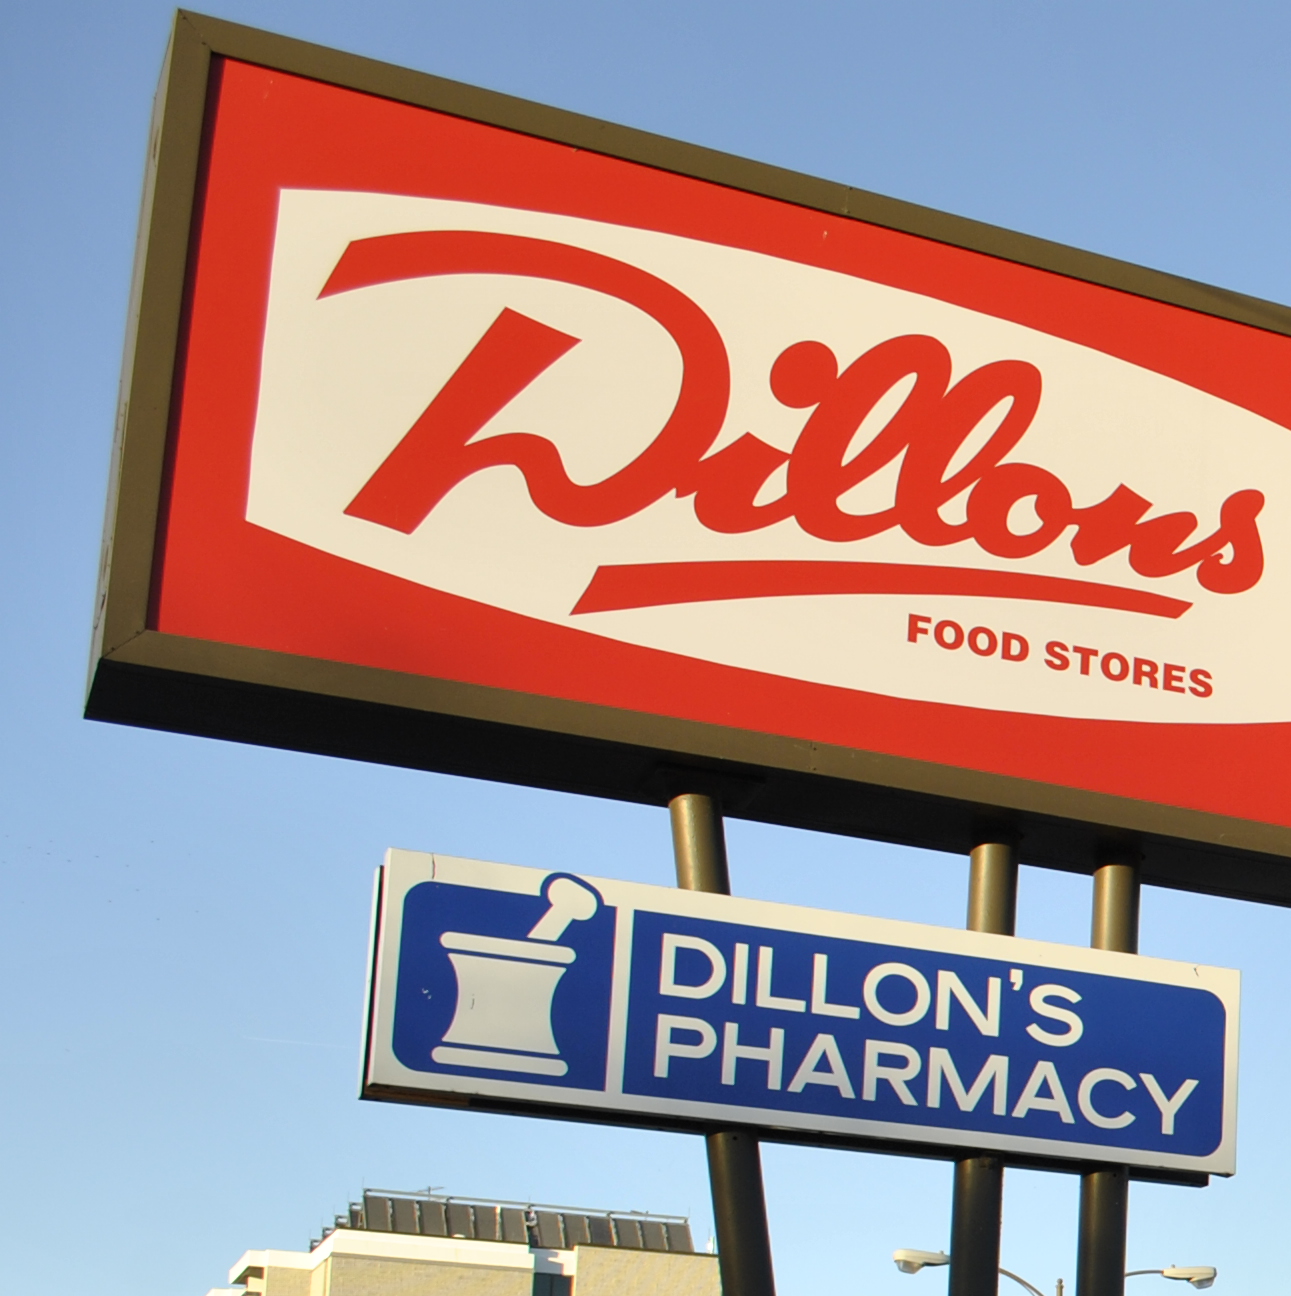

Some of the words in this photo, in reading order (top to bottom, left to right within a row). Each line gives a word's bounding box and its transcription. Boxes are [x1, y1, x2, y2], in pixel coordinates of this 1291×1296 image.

[316, 229, 1265, 595] Dillons
[906, 614, 1030, 664] FOOD
[1043, 640, 1215, 699] STORES
[660, 932, 1085, 1048] DILLON'S
[654, 1014, 1200, 1136] PHARMACY
